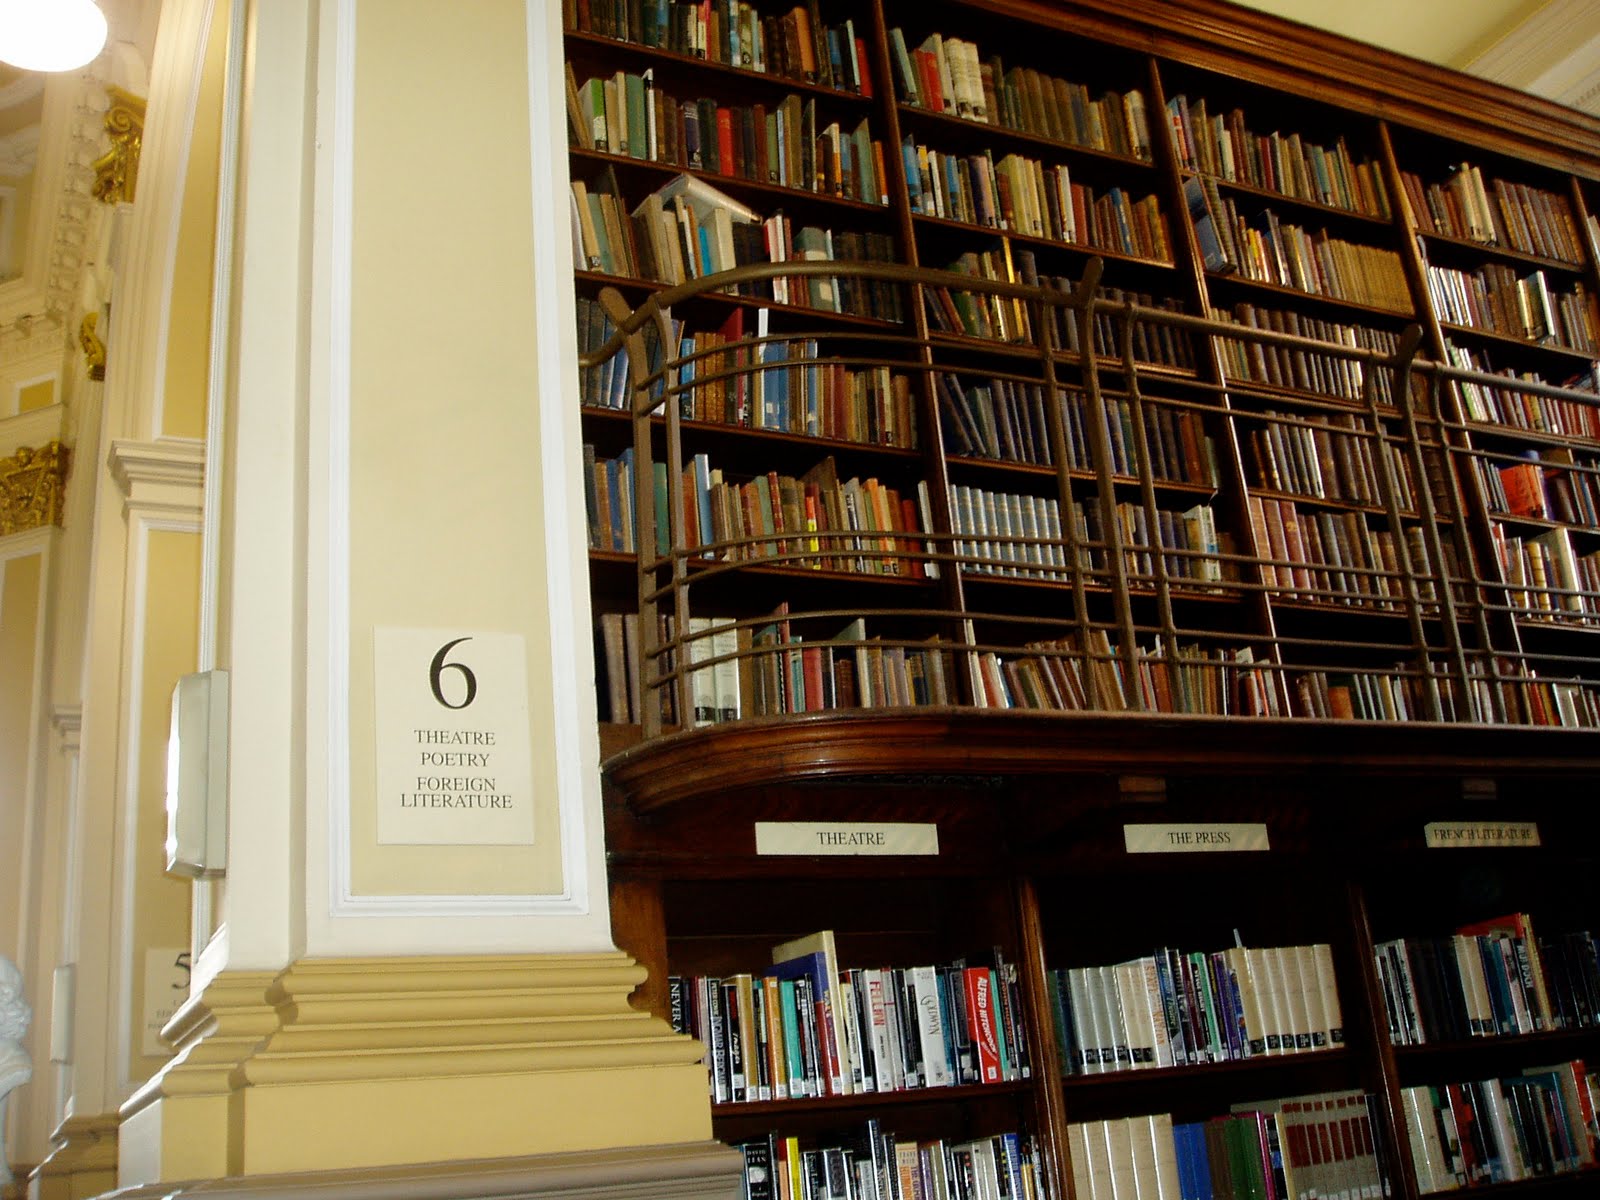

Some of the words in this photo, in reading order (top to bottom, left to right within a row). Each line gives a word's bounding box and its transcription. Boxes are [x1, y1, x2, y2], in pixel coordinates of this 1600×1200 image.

[429, 637, 477, 709] 6
[414, 730, 496, 745] THEATRE
[421, 752, 490, 767] POETRY
[417, 777, 496, 791] FOREIGN
[401, 794, 513, 808] LITERATURE
[816, 832, 885, 845] THEATRE
[1168, 832, 1193, 844] THE
[1196, 832, 1231, 844] PRESS
[1434, 829, 1475, 840] FRENCH
[1477, 828, 1532, 840] LITERATURE
[172, 953, 191, 989] 5
[977, 977, 988, 1008] ALFRED
[670, 983, 682, 1022] NEVER
[869, 981, 886, 1026] FELLINI
[979, 1009, 997, 1054] HITCHCOCK
